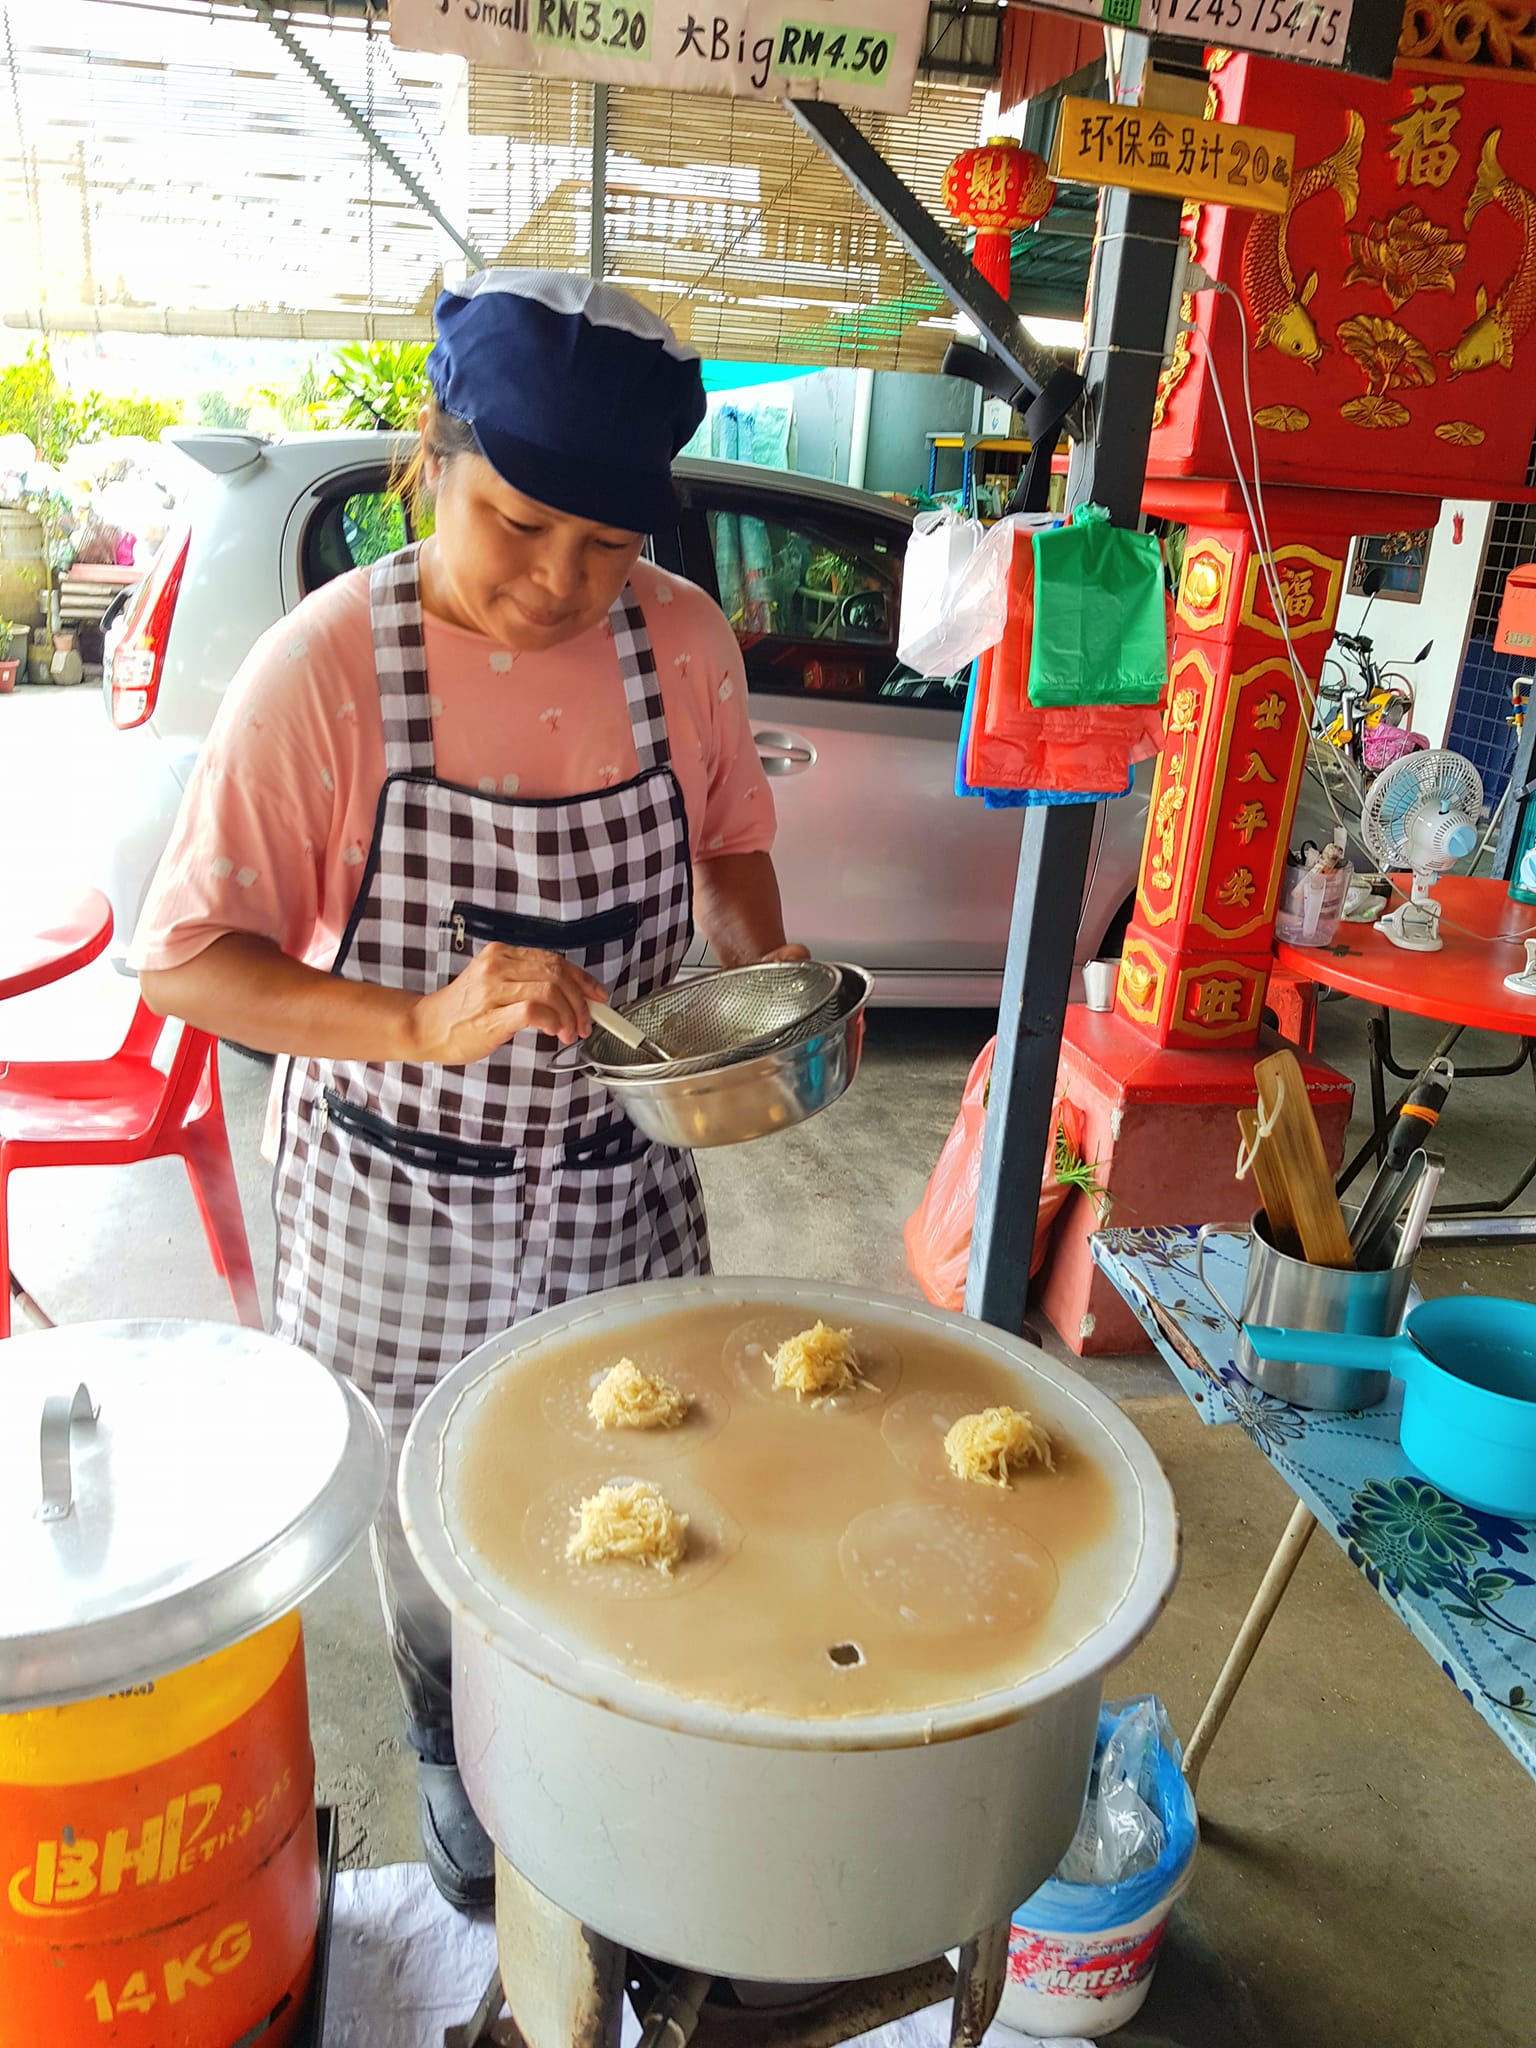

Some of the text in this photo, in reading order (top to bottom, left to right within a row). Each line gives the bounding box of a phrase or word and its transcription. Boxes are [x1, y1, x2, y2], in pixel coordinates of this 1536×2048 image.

[675, 13, 706, 58] 大
[710, 17, 888, 88] Big RM4.50
[1390, 85, 1465, 188] 福
[1272, 567, 1315, 618] 福
[1219, 692, 1287, 908] 出入平安
[1196, 978, 1243, 1023] 旺
